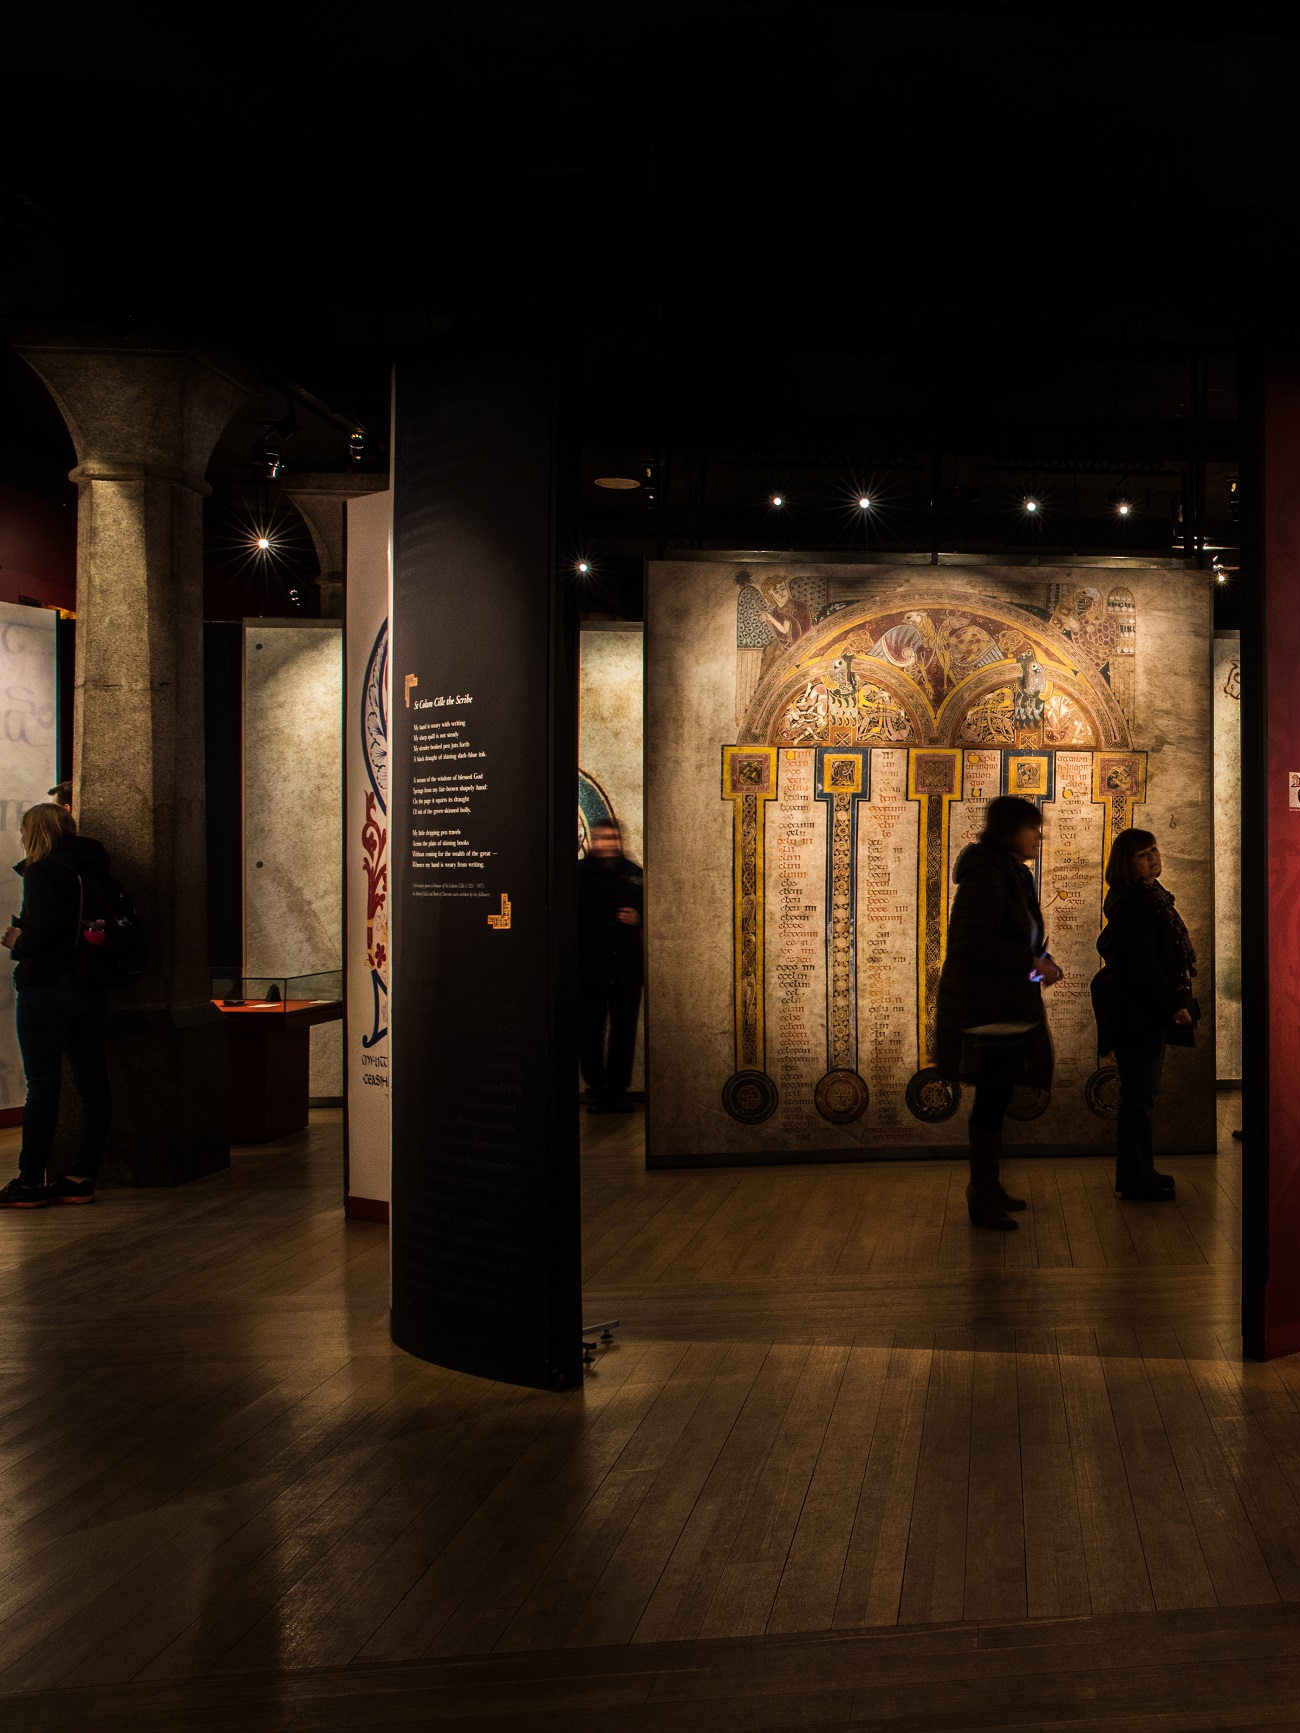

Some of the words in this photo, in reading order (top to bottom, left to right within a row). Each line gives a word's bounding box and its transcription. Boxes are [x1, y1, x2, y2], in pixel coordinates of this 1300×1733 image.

[446, 696, 455, 705] the
[455, 694, 473, 705] Scribe
[473, 772, 483, 780] God
